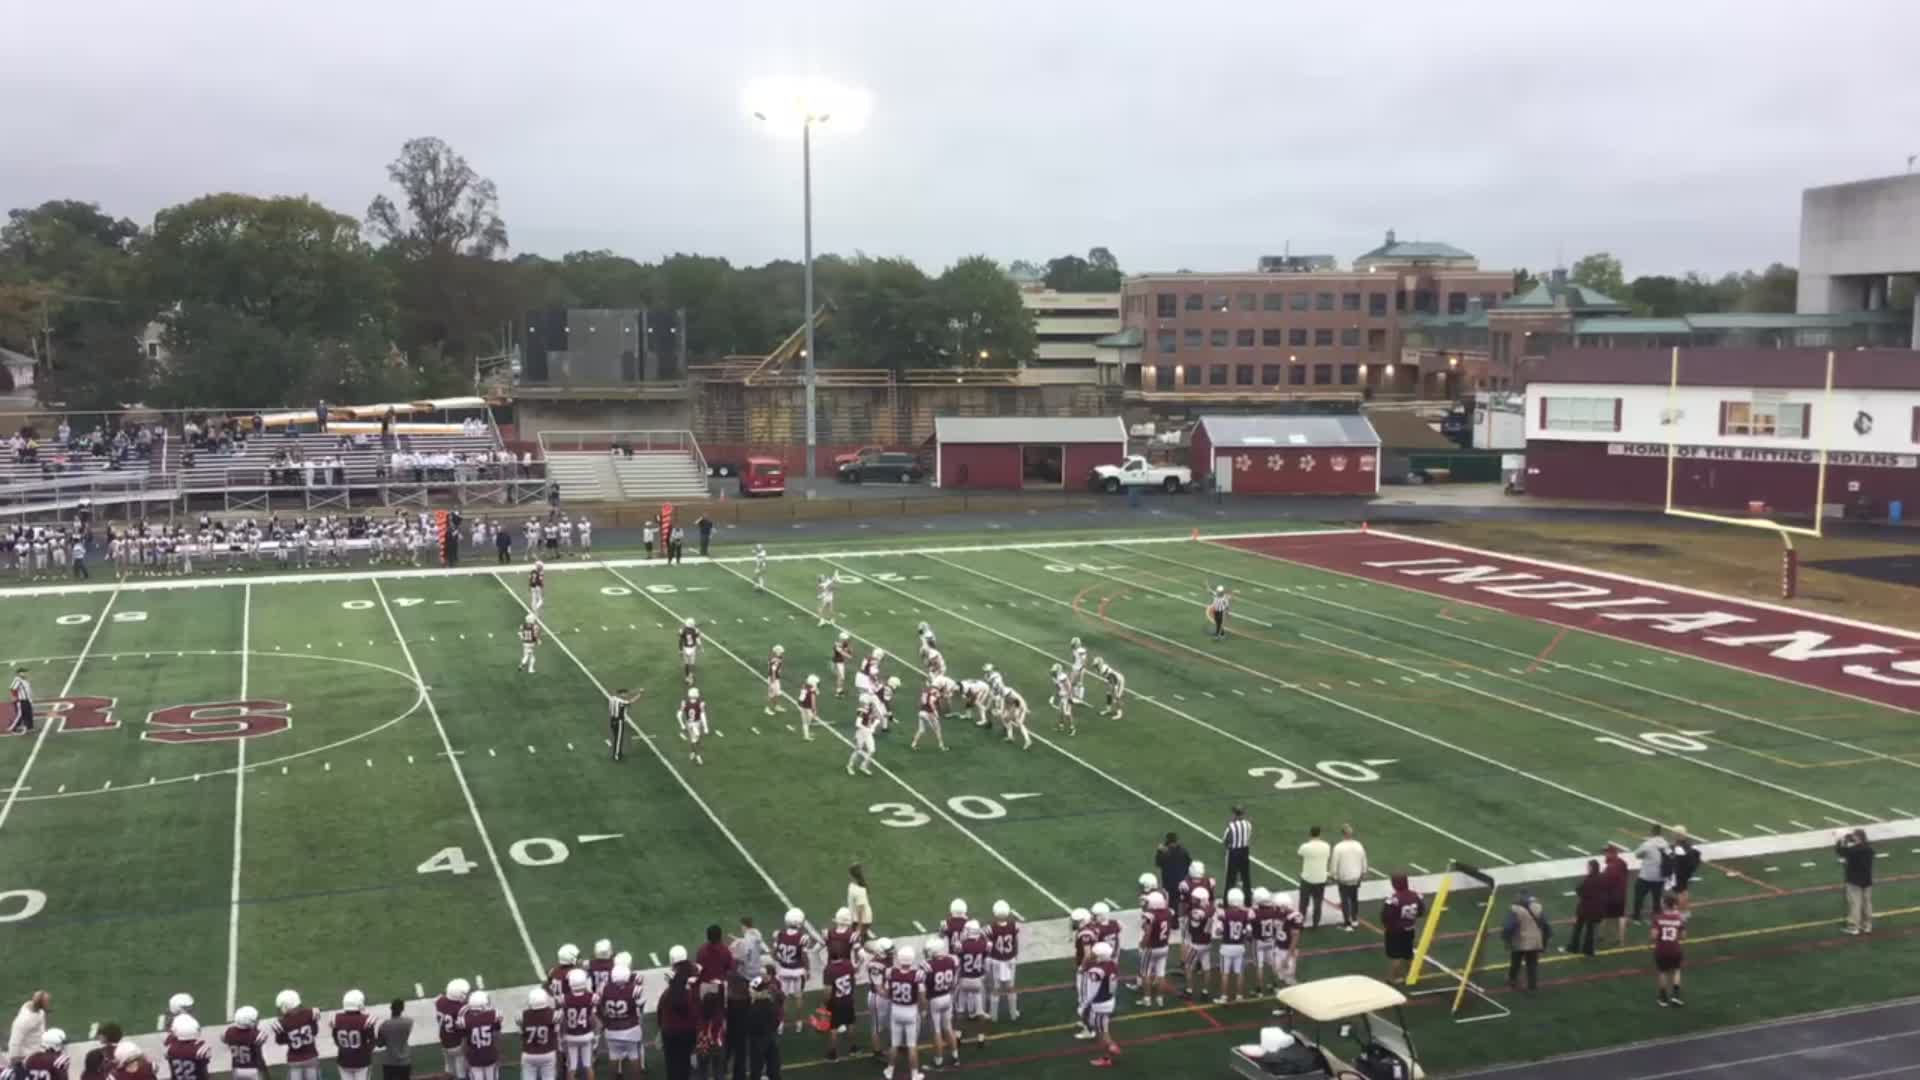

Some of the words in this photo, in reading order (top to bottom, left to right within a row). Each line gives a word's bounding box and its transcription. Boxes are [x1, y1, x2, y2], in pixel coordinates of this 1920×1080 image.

[1678, 446, 1701, 458] OF
[1705, 447, 1736, 460] THE
[1740, 449, 1813, 463] HITTING
[995, 934, 1014, 954] 43
[963, 952, 983, 972] 24
[567, 1007, 588, 1029] 84
[287, 1025, 315, 1050] 53
[337, 1029, 362, 1050] 60
[471, 1024, 493, 1050] 45
